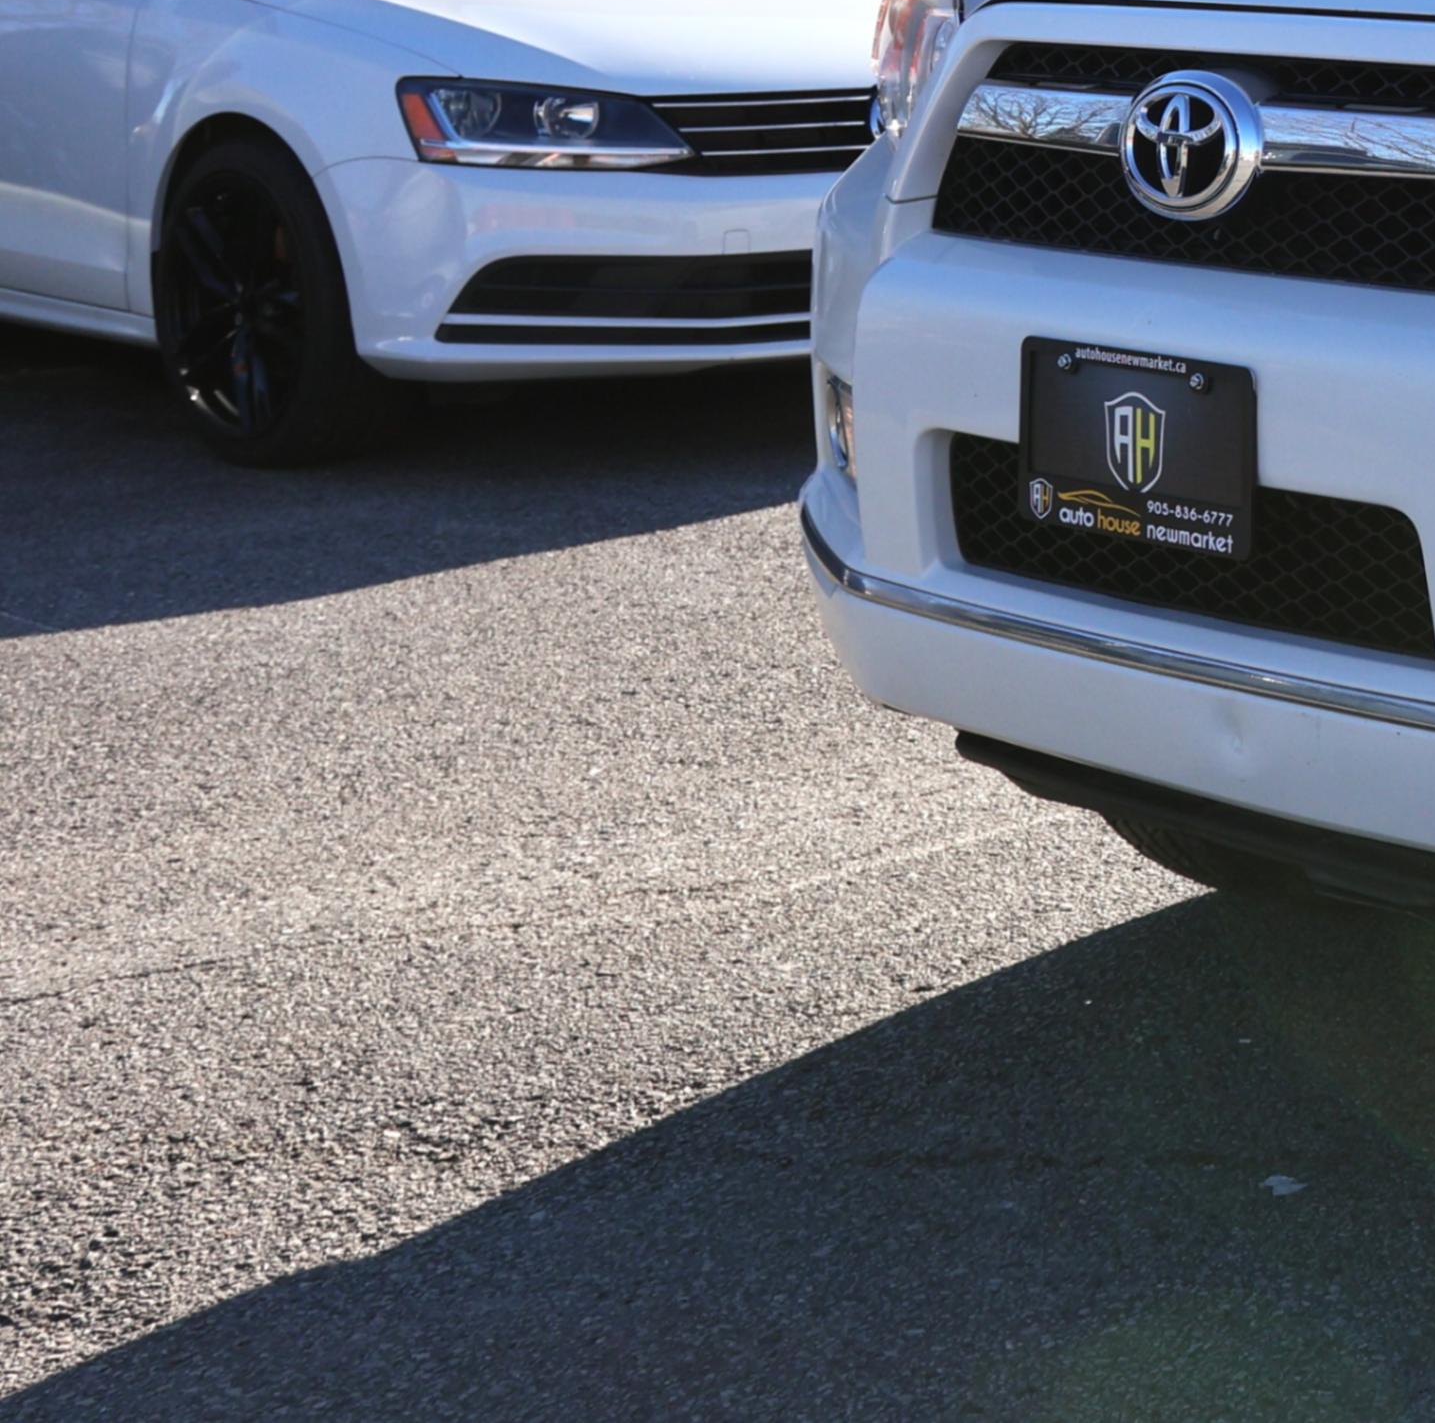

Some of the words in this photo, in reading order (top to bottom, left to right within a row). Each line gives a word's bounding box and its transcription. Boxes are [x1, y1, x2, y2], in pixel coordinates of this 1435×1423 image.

[1075, 347, 1187, 374] autohousenewmarket.ca
[1059, 506, 1095, 528] auto
[1097, 509, 1141, 537] house
[1146, 500, 1234, 527] 905-836-6777
[1146, 524, 1234, 554] newmarket
